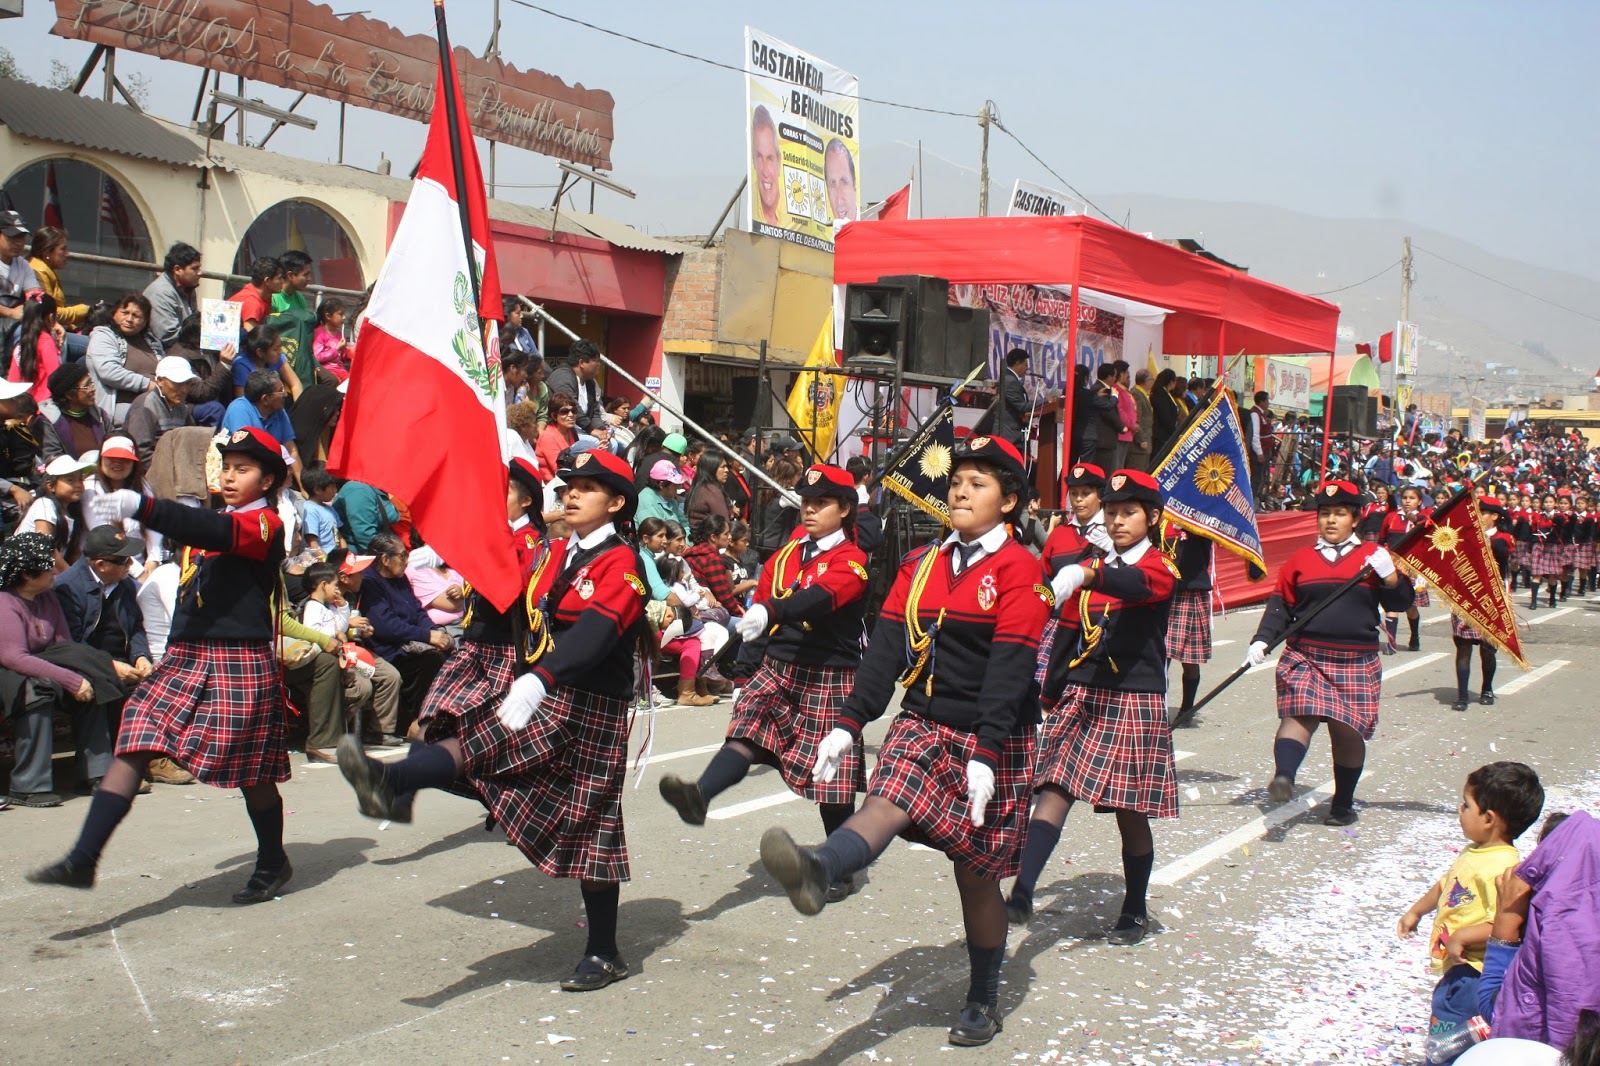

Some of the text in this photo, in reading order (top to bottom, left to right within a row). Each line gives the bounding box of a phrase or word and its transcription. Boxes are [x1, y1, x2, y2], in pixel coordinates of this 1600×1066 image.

[366, 50, 435, 113] Bras
[751, 39, 823, 95] CASTAÑEDA
[791, 90, 854, 139] BENAVIDES
[1014, 189, 1065, 216] CASTAÑEDA
[760, 224, 783, 238] JUNTOS
[783, 230, 795, 241] POR
[796, 233, 803, 244] EL
[980, 284, 1008, 305] Feliz
[1042, 341, 1105, 390] CLRA
[1202, 409, 1222, 429] SUIZO
[924, 492, 951, 515] ANIVERS
[1166, 496, 1195, 515] DESFILE
[1406, 553, 1424, 569] LVIII
[1423, 566, 1443, 585] ANIV.
[1460, 599, 1472, 610] DE
[1470, 608, 1498, 633] ESCOLAR
[1450, 551, 1499, 621] HONOR AL MERITO
